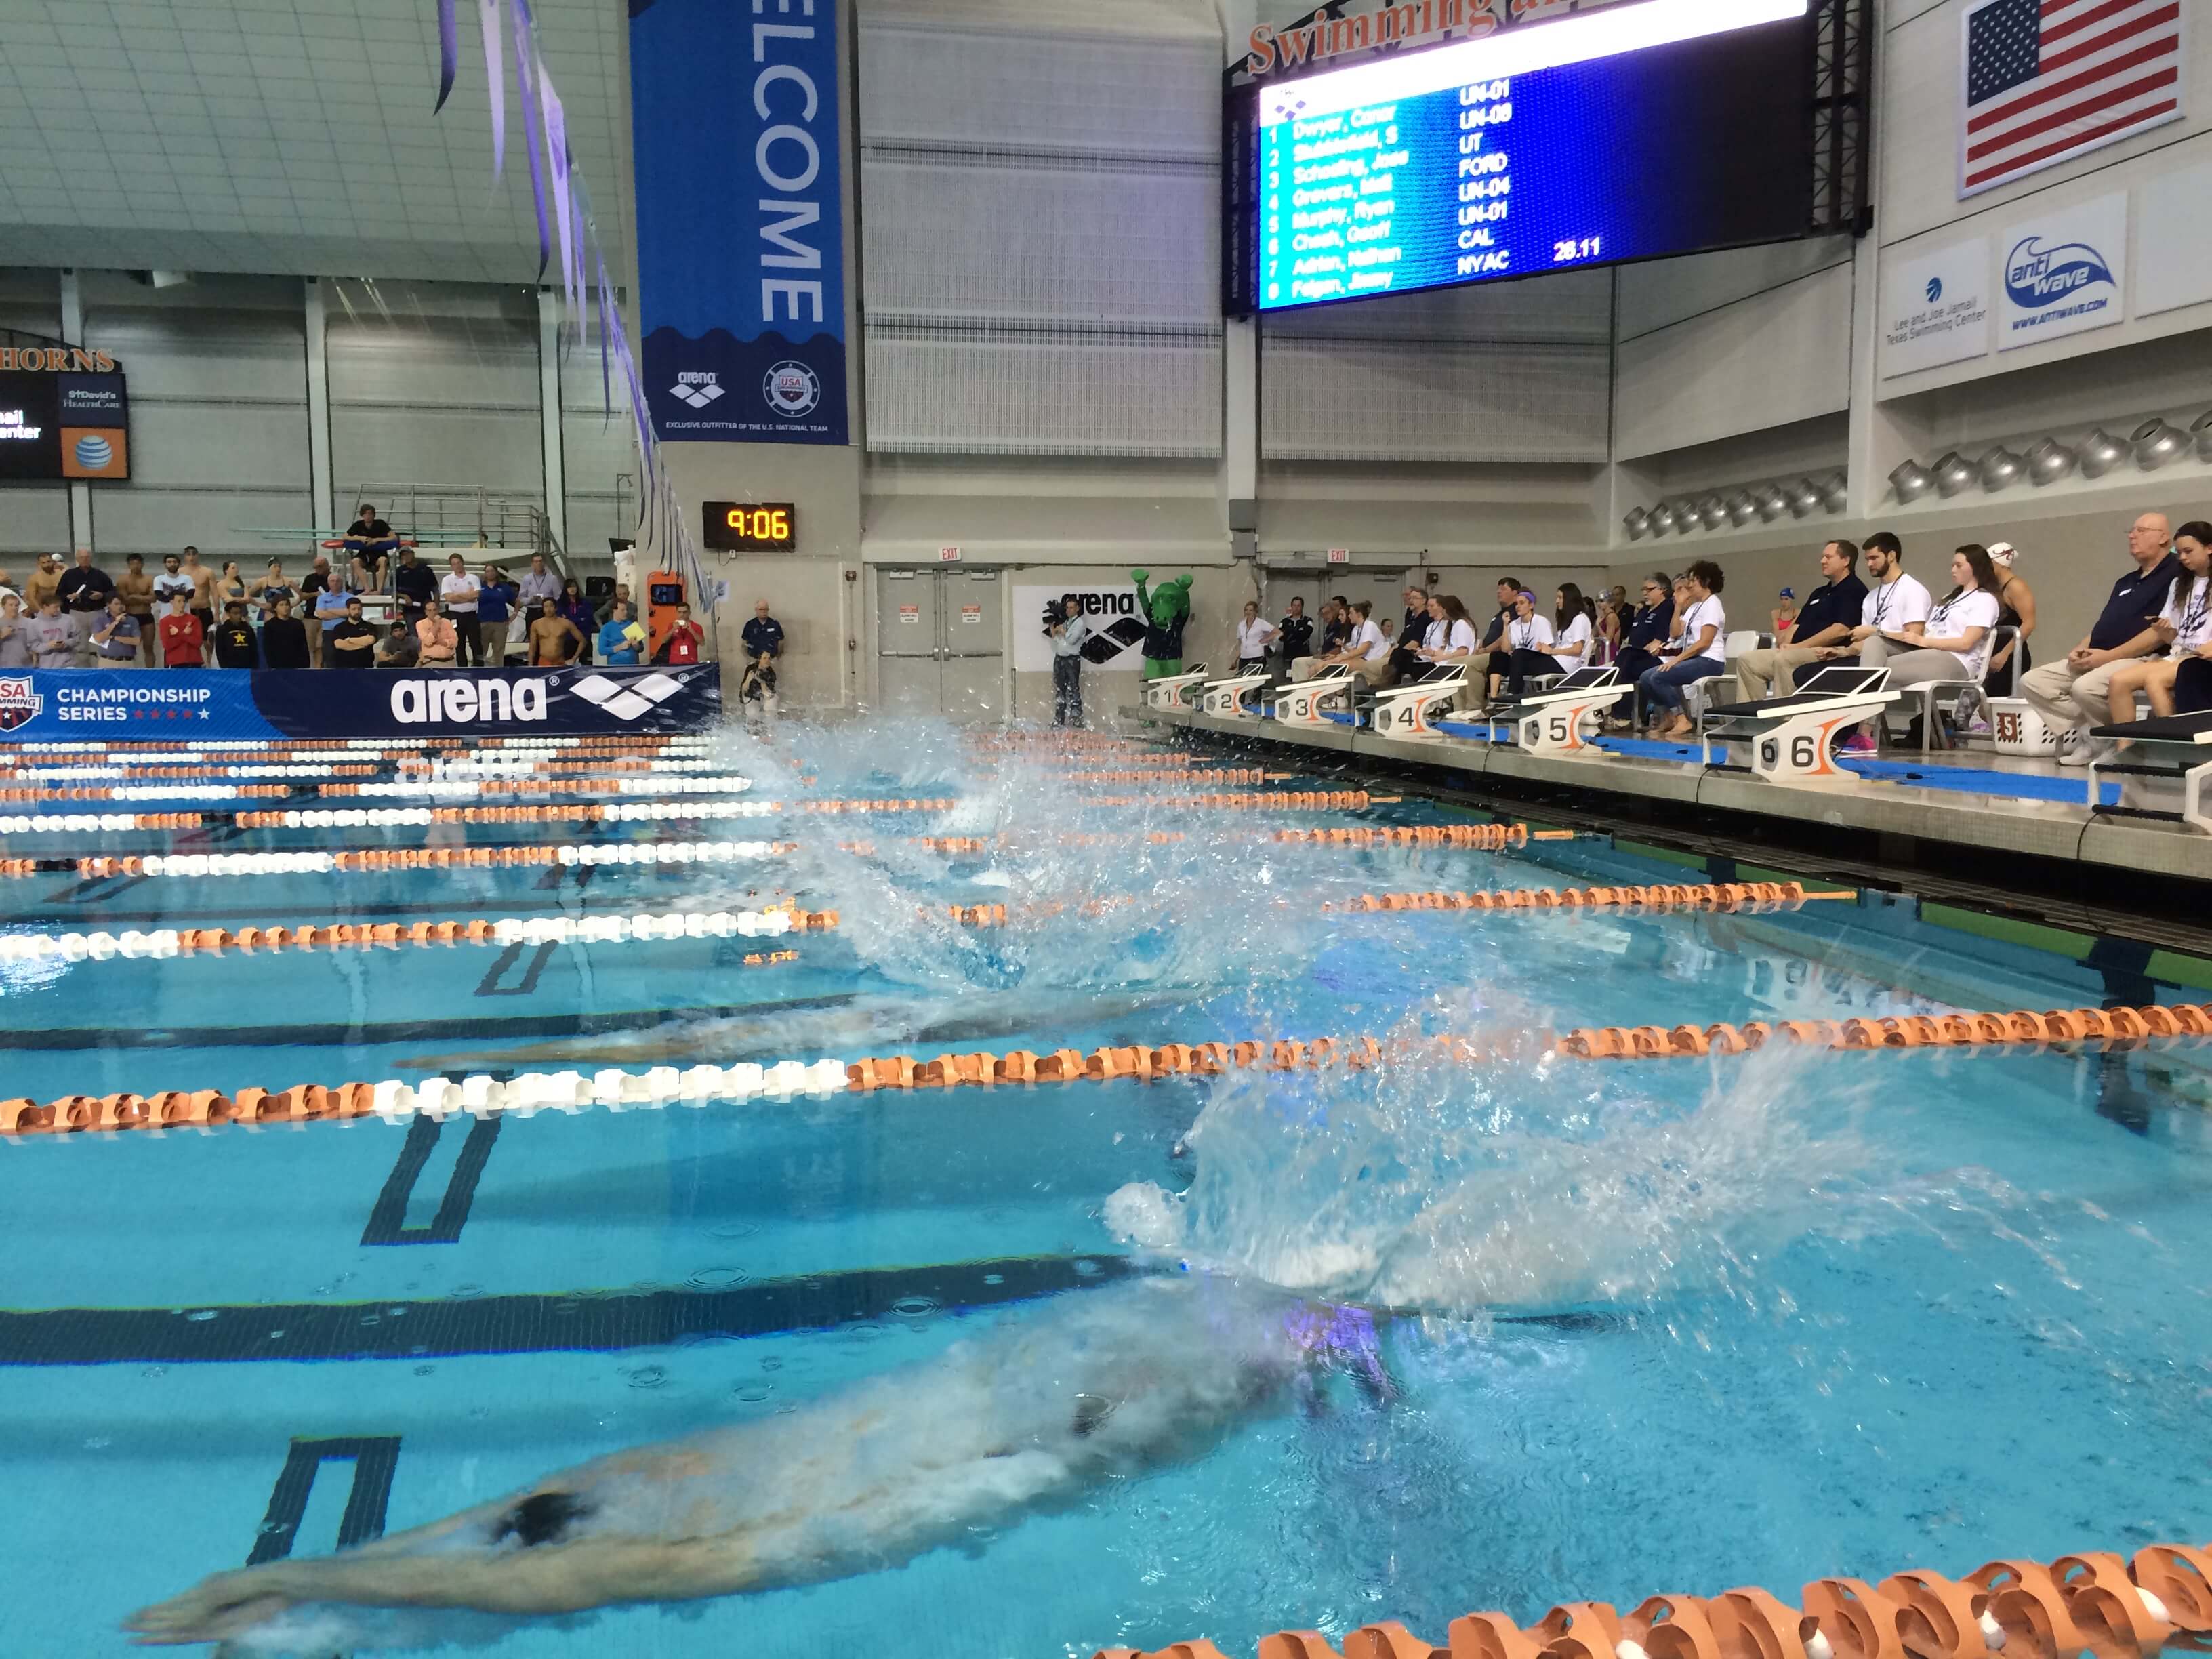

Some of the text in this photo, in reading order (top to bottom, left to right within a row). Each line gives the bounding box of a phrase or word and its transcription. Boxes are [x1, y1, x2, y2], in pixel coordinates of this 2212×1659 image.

[1247, 0, 1496, 76] Swimming
[1459, 132, 1483, 154] UT
[1458, 152, 1508, 178] FORD
[1458, 228, 1495, 249] CAL
[1457, 250, 1510, 275] NYAC
[2012, 253, 2051, 283] anti
[2034, 266, 2090, 296] wave
[1887, 310, 1986, 346] Texas Swimming Center
[1894, 319, 1910, 331] Lee
[1911, 310, 1927, 326] and
[1929, 308, 1945, 321] Joe
[678, 371, 716, 384] arena
[781, 377, 801, 386] USA
[775, 424, 808, 432] NATIONAL
[727, 510, 788, 539] 9:06
[942, 547, 958, 560] EXIT
[1331, 550, 1345, 562] EXIT
[57, 689, 211, 704] CHAMPIONSHIP
[390, 678, 548, 724] arena
[1164, 690, 1171, 703] 1
[1221, 694, 1232, 708] 2
[58, 707, 127, 721] SERIES
[1296, 699, 1309, 716] 3
[1398, 707, 1414, 726] 4
[1549, 717, 1567, 741] 5
[2004, 716, 2013, 737] 5
[1791, 735, 1814, 767] 6
